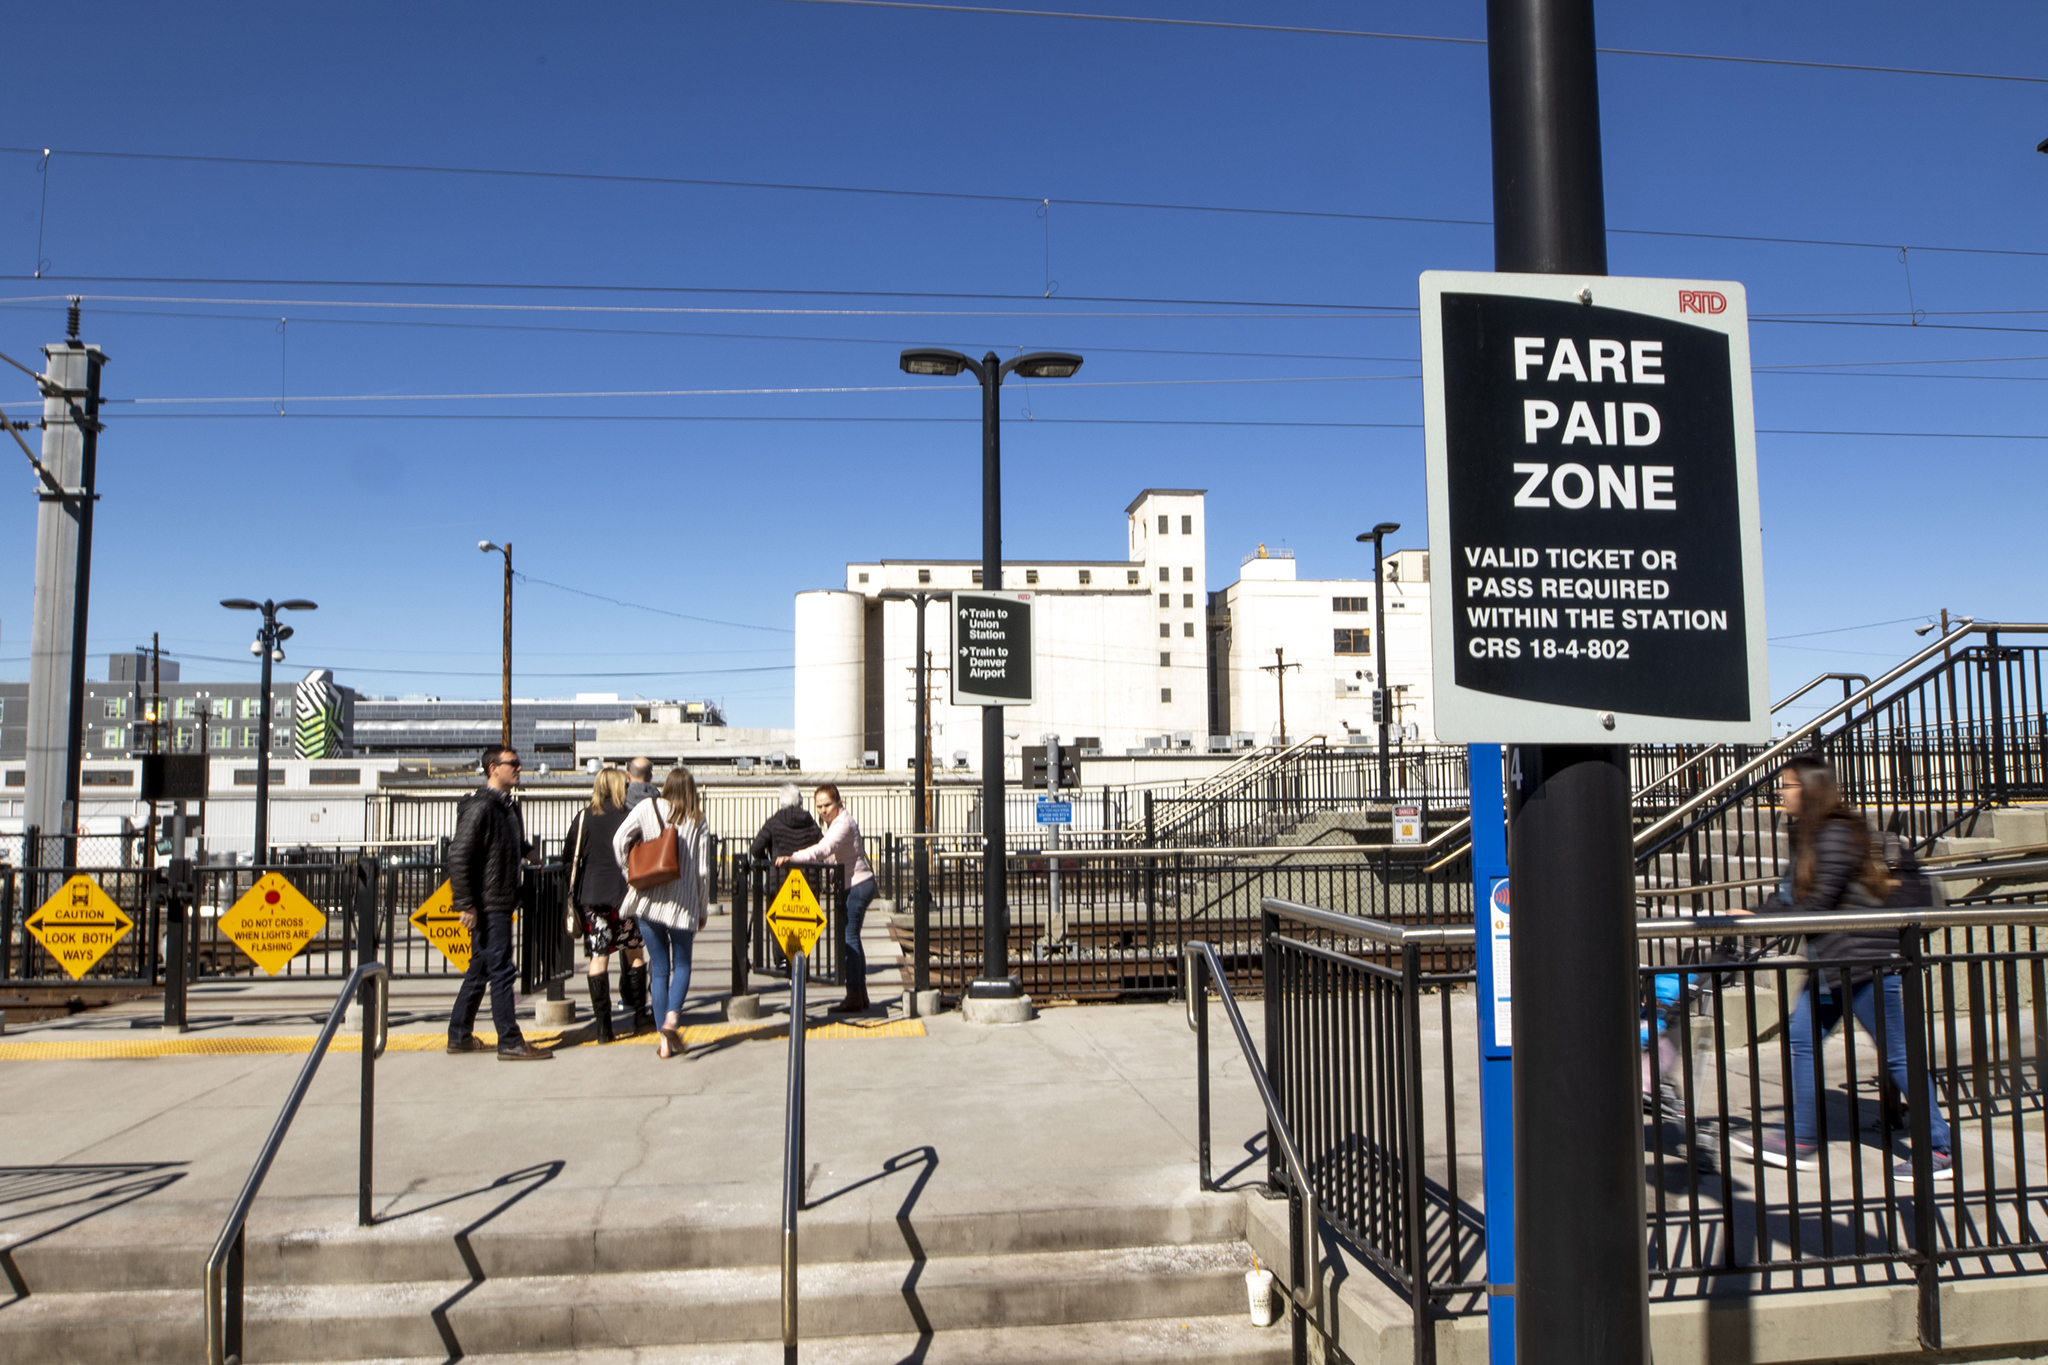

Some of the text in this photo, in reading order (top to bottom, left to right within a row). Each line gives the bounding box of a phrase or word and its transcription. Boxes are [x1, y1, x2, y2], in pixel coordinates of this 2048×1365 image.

[1678, 290, 1727, 314] RTD
[1514, 337, 1665, 384] FARE
[1523, 400, 1661, 447] PAID
[1513, 462, 1677, 510] ZONE
[1465, 547, 1677, 570] VALID TICKET OR
[1467, 577, 1670, 600] PASS REQUIRED
[969, 608, 1008, 619] Train to
[1467, 607, 1727, 630] WITHIN THE STATION
[969, 619, 999, 629] Union
[969, 629, 1006, 640] Station
[969, 646, 1009, 657] Train to
[1469, 637, 1630, 660] CRS 18-4-802
[969, 657, 1006, 667] Denver
[969, 668, 1006, 680] Airport
[1510, 747, 1523, 790] 4
[55, 910, 105, 919] CAUTION
[782, 904, 810, 914] CAUTION
[241, 918, 303, 928] DO NOT CROSS
[234, 930, 309, 940] WHEN LIGHTS ARE
[430, 927, 461, 938] LOOK
[778, 927, 816, 939] LOOK BOTH
[45, 933, 113, 944] LOOK BOTH
[251, 942, 293, 952] FLASHING
[448, 943, 472, 954] WAY
[63, 949, 94, 960] WAYS
